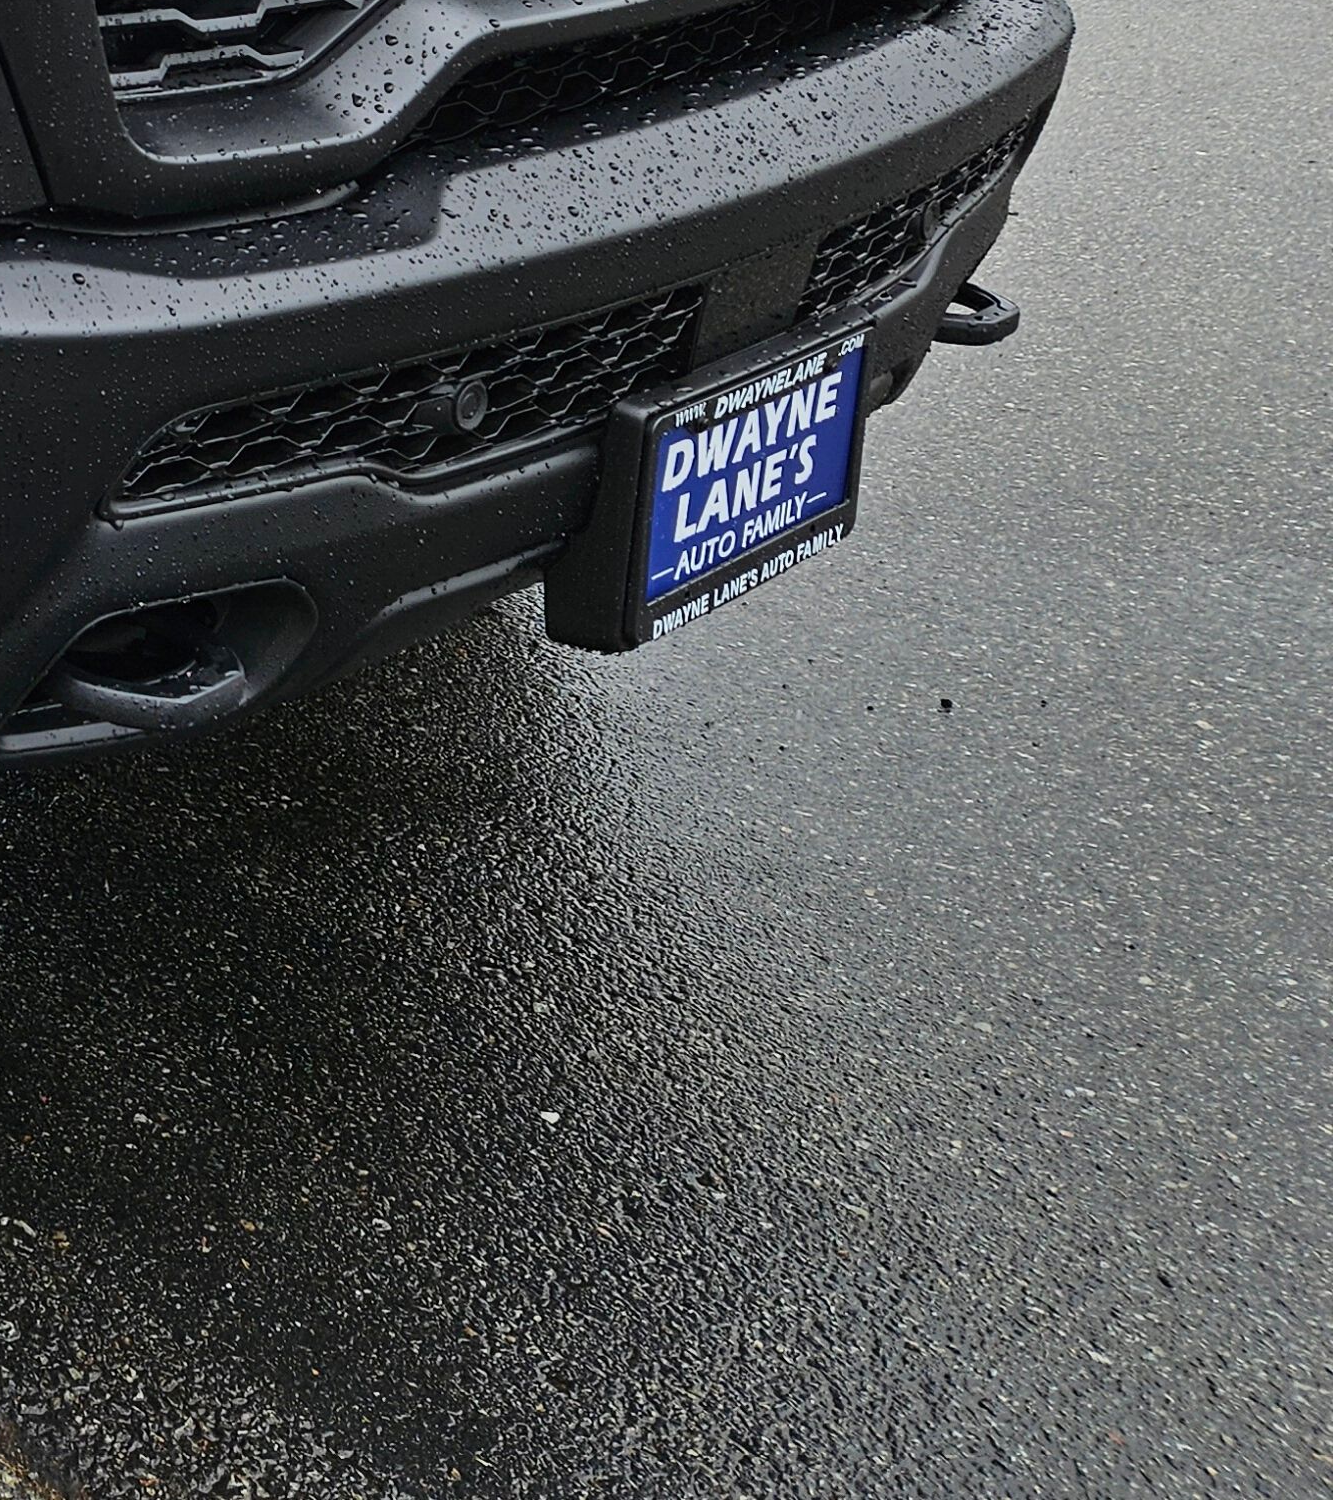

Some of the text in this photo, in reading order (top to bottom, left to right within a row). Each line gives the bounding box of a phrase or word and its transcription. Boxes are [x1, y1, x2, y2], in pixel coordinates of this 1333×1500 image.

[661, 371, 843, 492] DWAYNE
[714, 352, 828, 420] DWAYNELANE
[672, 434, 817, 543] LANE'S
[673, 491, 807, 581] AUTO FAMILY
[652, 523, 845, 641] DWAYNE LANE'S AUTO FAMILY
